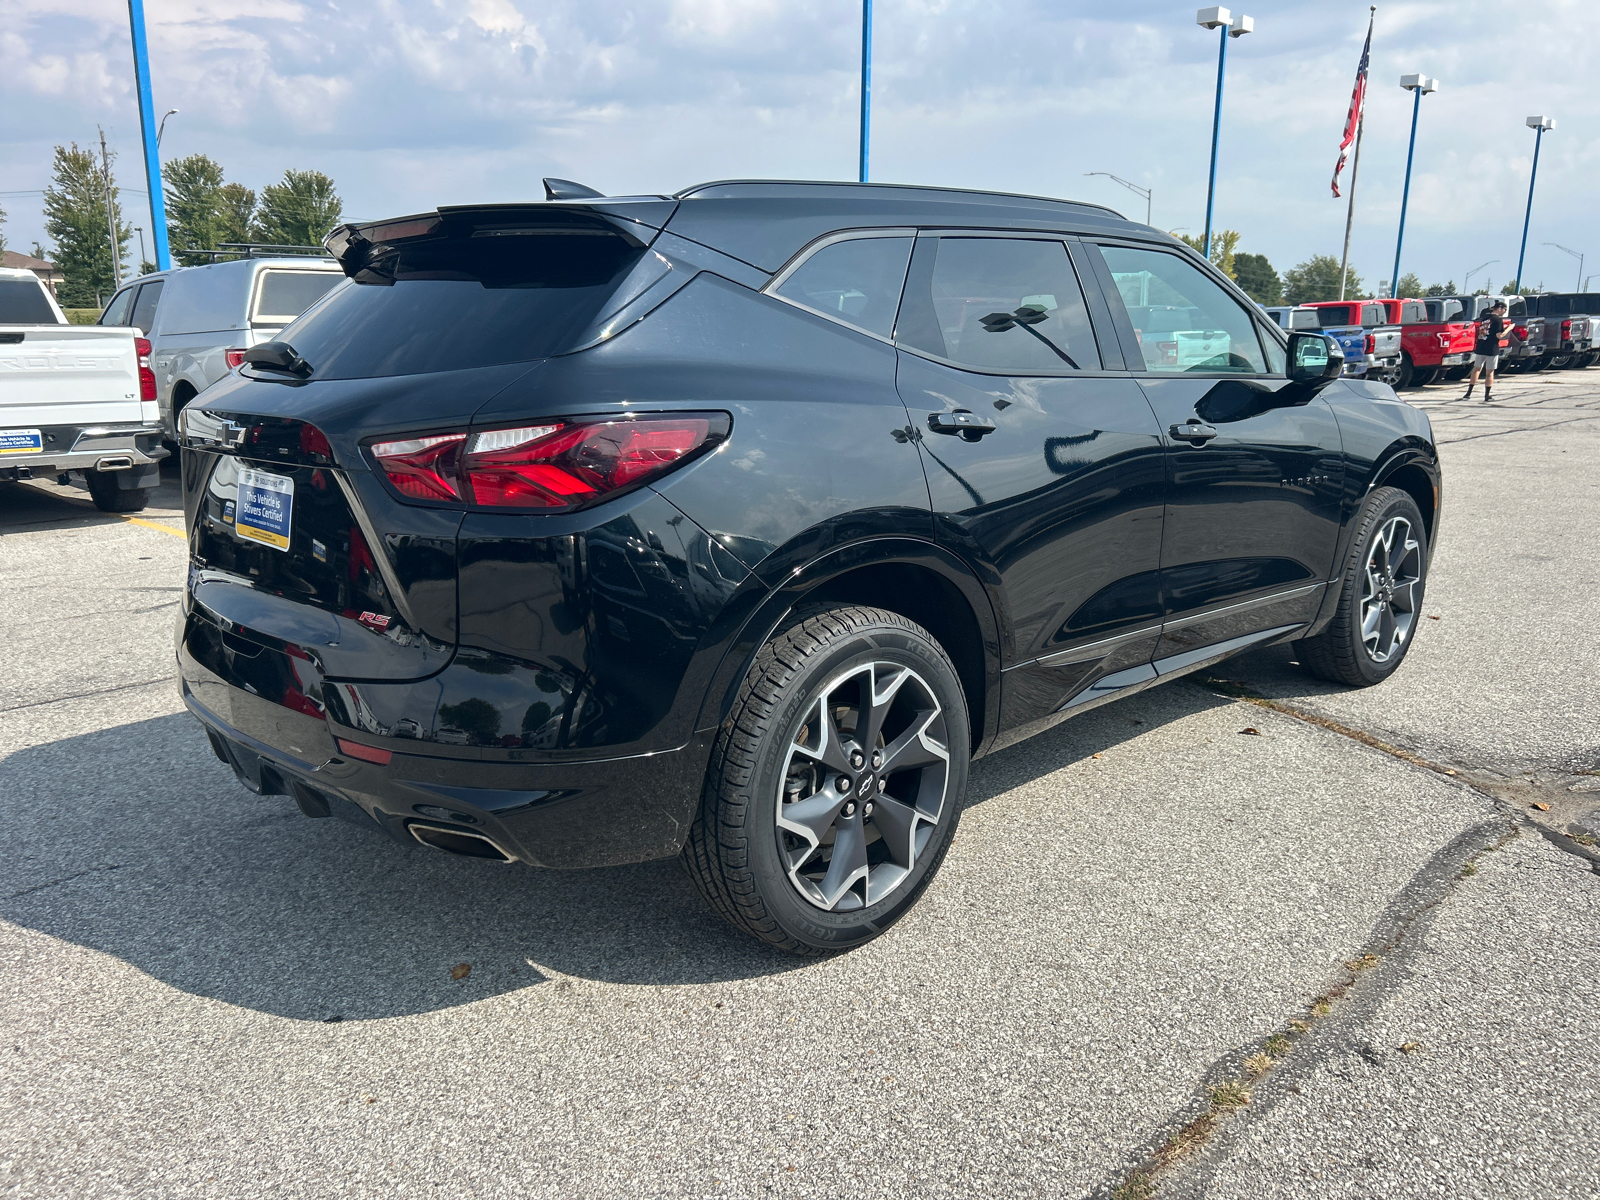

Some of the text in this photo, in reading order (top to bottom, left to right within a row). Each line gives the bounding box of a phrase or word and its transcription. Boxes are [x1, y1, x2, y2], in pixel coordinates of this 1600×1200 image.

[246, 491, 281, 509] This Vehicle is
[243, 503, 261, 516] Stivers
[262, 506, 283, 522] Certified
[358, 610, 392, 626] RS
[905, 639, 946, 672] KELLY
[790, 914, 837, 941] KELLY
